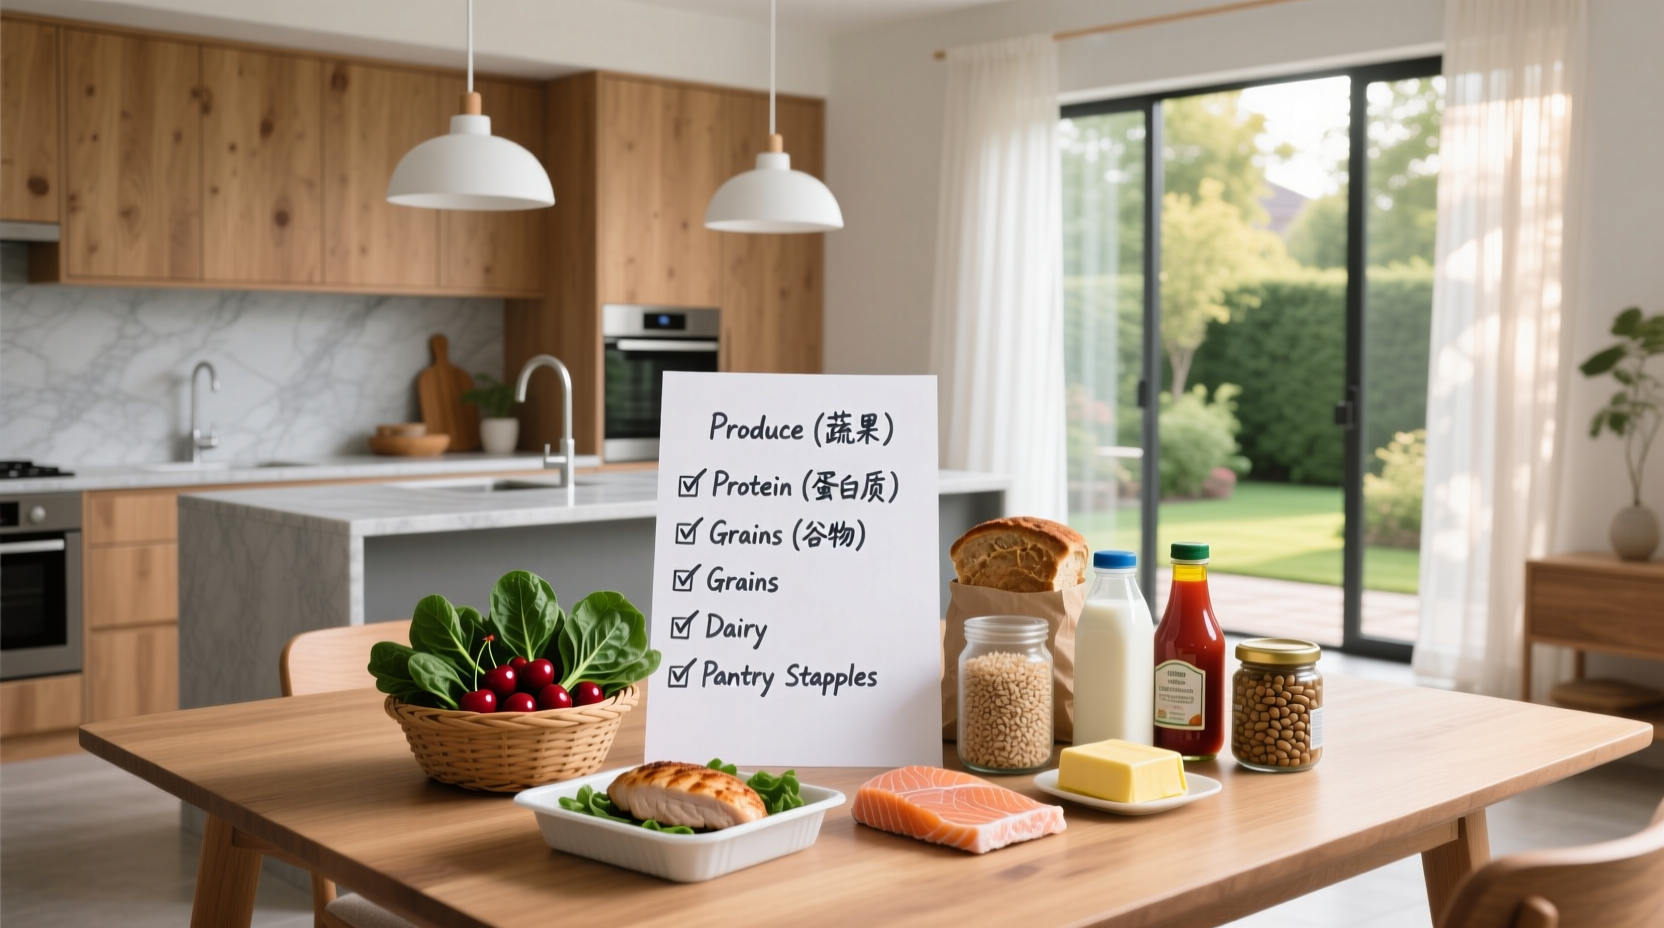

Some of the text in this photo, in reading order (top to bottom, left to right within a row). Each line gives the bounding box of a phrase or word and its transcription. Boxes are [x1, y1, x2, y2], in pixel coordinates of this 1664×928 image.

[709, 410, 894, 448] Produce (蔬果)
[712, 469, 899, 504] Protein (蛋白质)
[709, 518, 866, 552] Grains (谷物)
[706, 566, 779, 593] Grains
[705, 612, 768, 650] Dairy
[701, 660, 878, 698] Pantry Stapples
